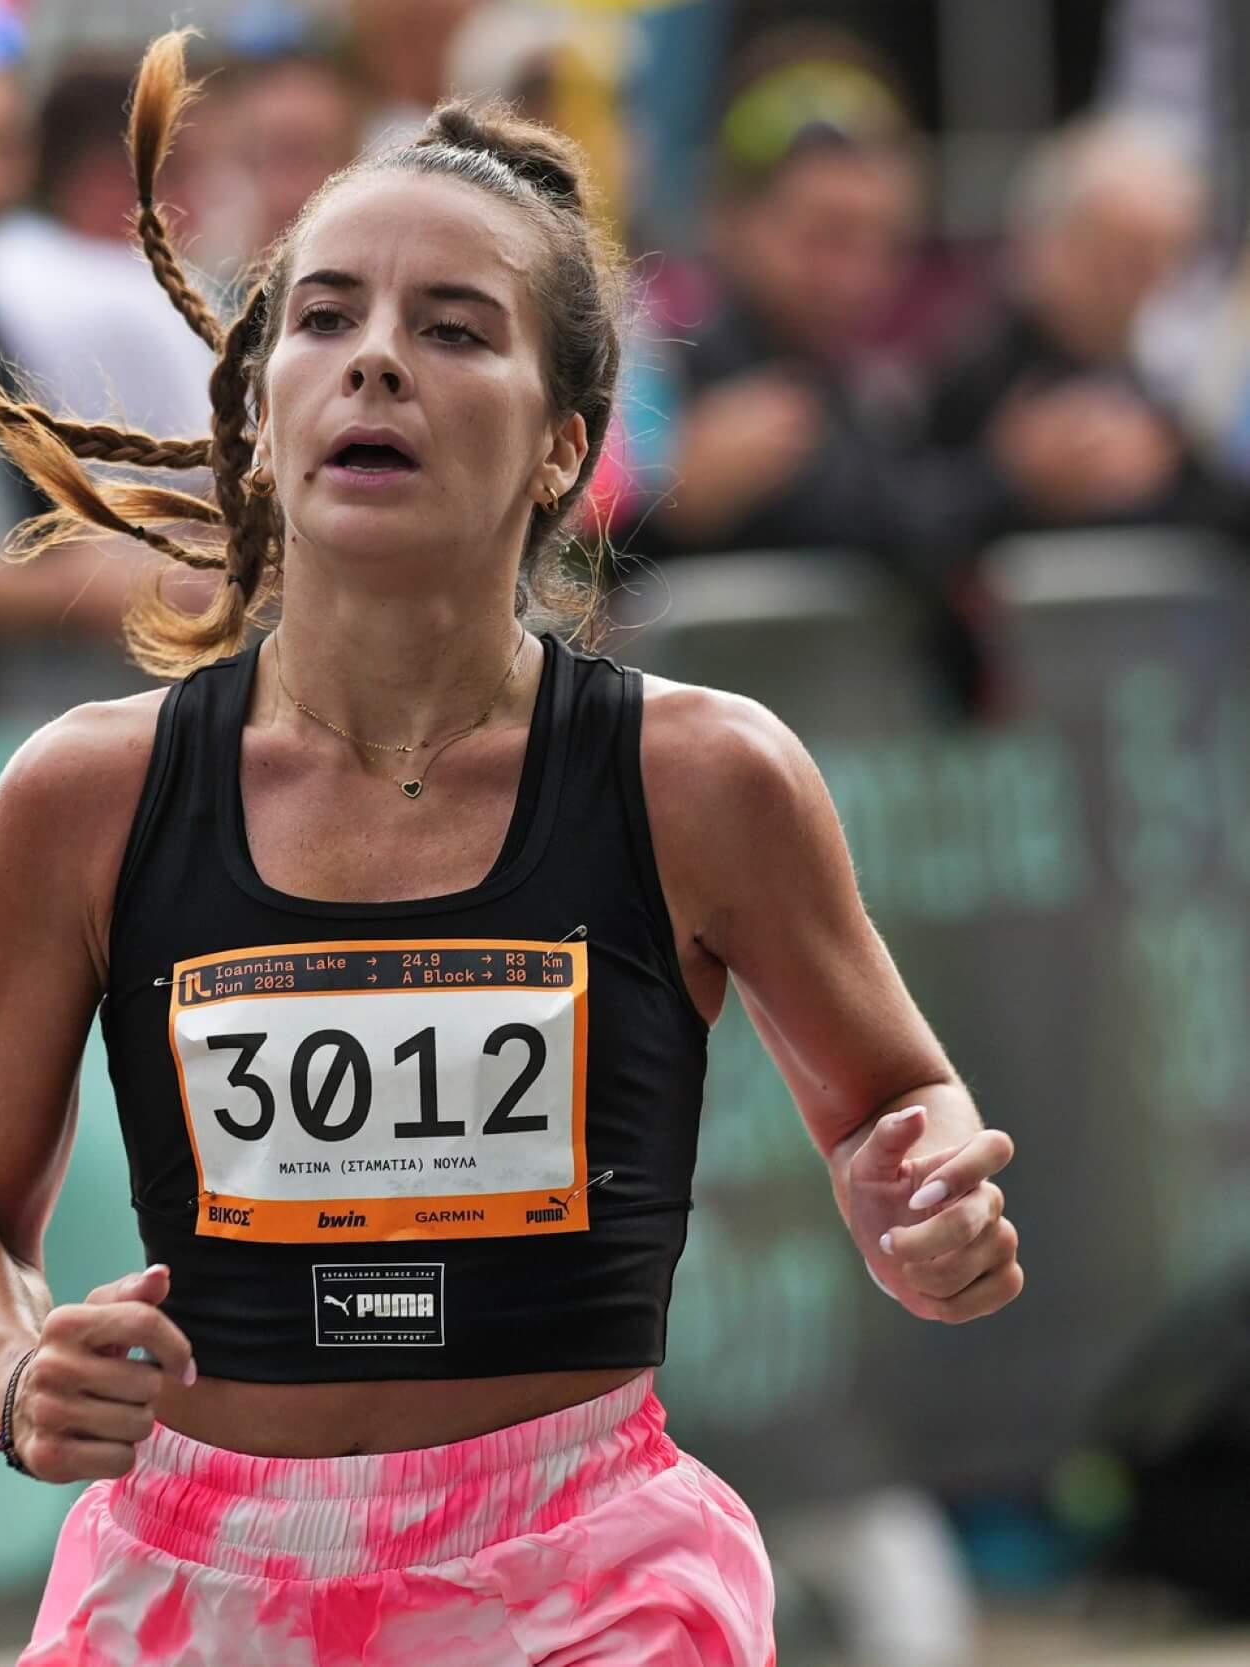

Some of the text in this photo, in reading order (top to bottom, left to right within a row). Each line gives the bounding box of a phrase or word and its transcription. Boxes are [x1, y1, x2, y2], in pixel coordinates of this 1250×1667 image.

[215, 952, 564, 980] Ioannina Lake 24.9 R3 km
[215, 968, 564, 995] Run 2023 A Block 30 km
[206, 1022, 549, 1143] 3012
[279, 1156, 478, 1176] ΜΑΤΙΝΑ (ΣΤΑΜΑΤΙΑ) ΝΟΥΛΑ
[317, 1210, 367, 1229] bwin
[414, 1209, 486, 1224] GARMIN
[525, 1207, 565, 1225] PUMA
[356, 1293, 434, 1318] PUMA
